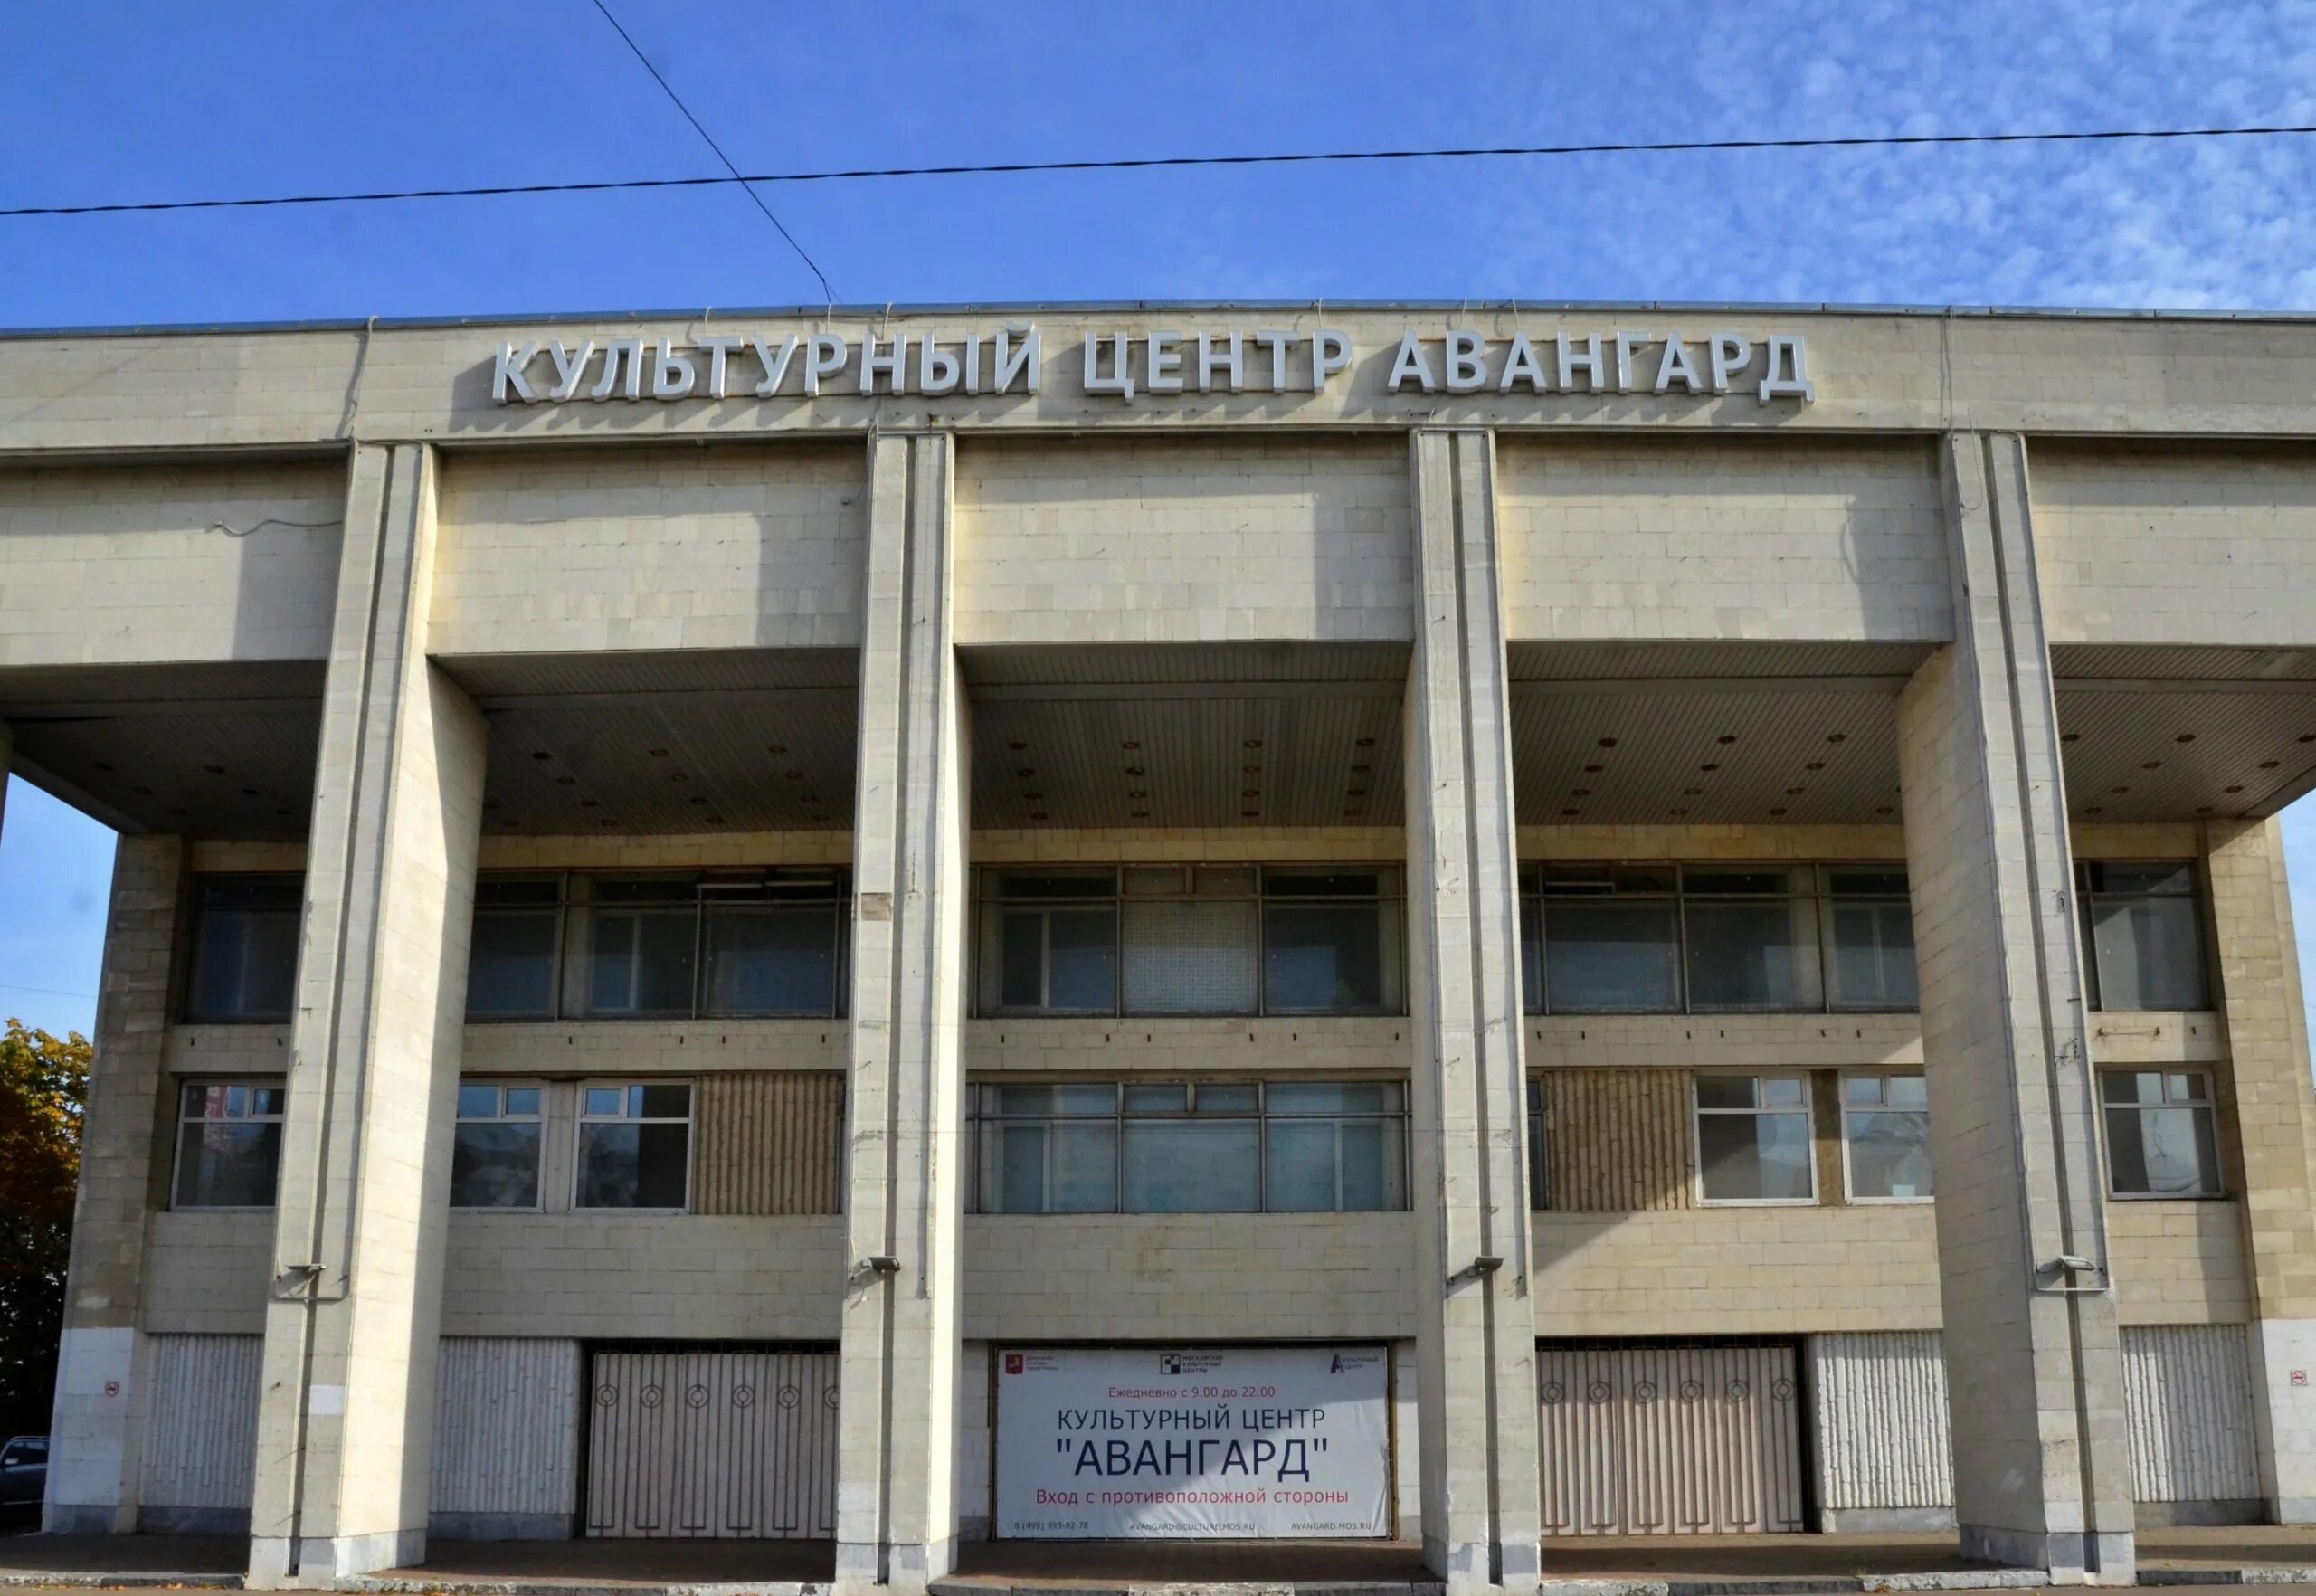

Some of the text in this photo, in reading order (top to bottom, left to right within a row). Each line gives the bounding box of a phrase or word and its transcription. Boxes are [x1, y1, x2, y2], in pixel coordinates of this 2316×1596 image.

[491, 319, 1815, 406] КУЛЬТУРНЫЙ ЦЕНТР АВАНГАРД
[1108, 1386, 1276, 1399] Ежедневно с 9.00 до 22.00
[1058, 1404, 1326, 1433] КУЛЬТУРНЫЙ ЦЕНТР
[1056, 1437, 1328, 1483] "АВАНГАРД"
[1036, 1487, 1349, 1506] Вход с противоположной стороны
[1013, 1521, 1020, 1530] 8
[1021, 1521, 1044, 1531] (495)
[1291, 1522, 1372, 1531] AVANGARD.MOS.RU
